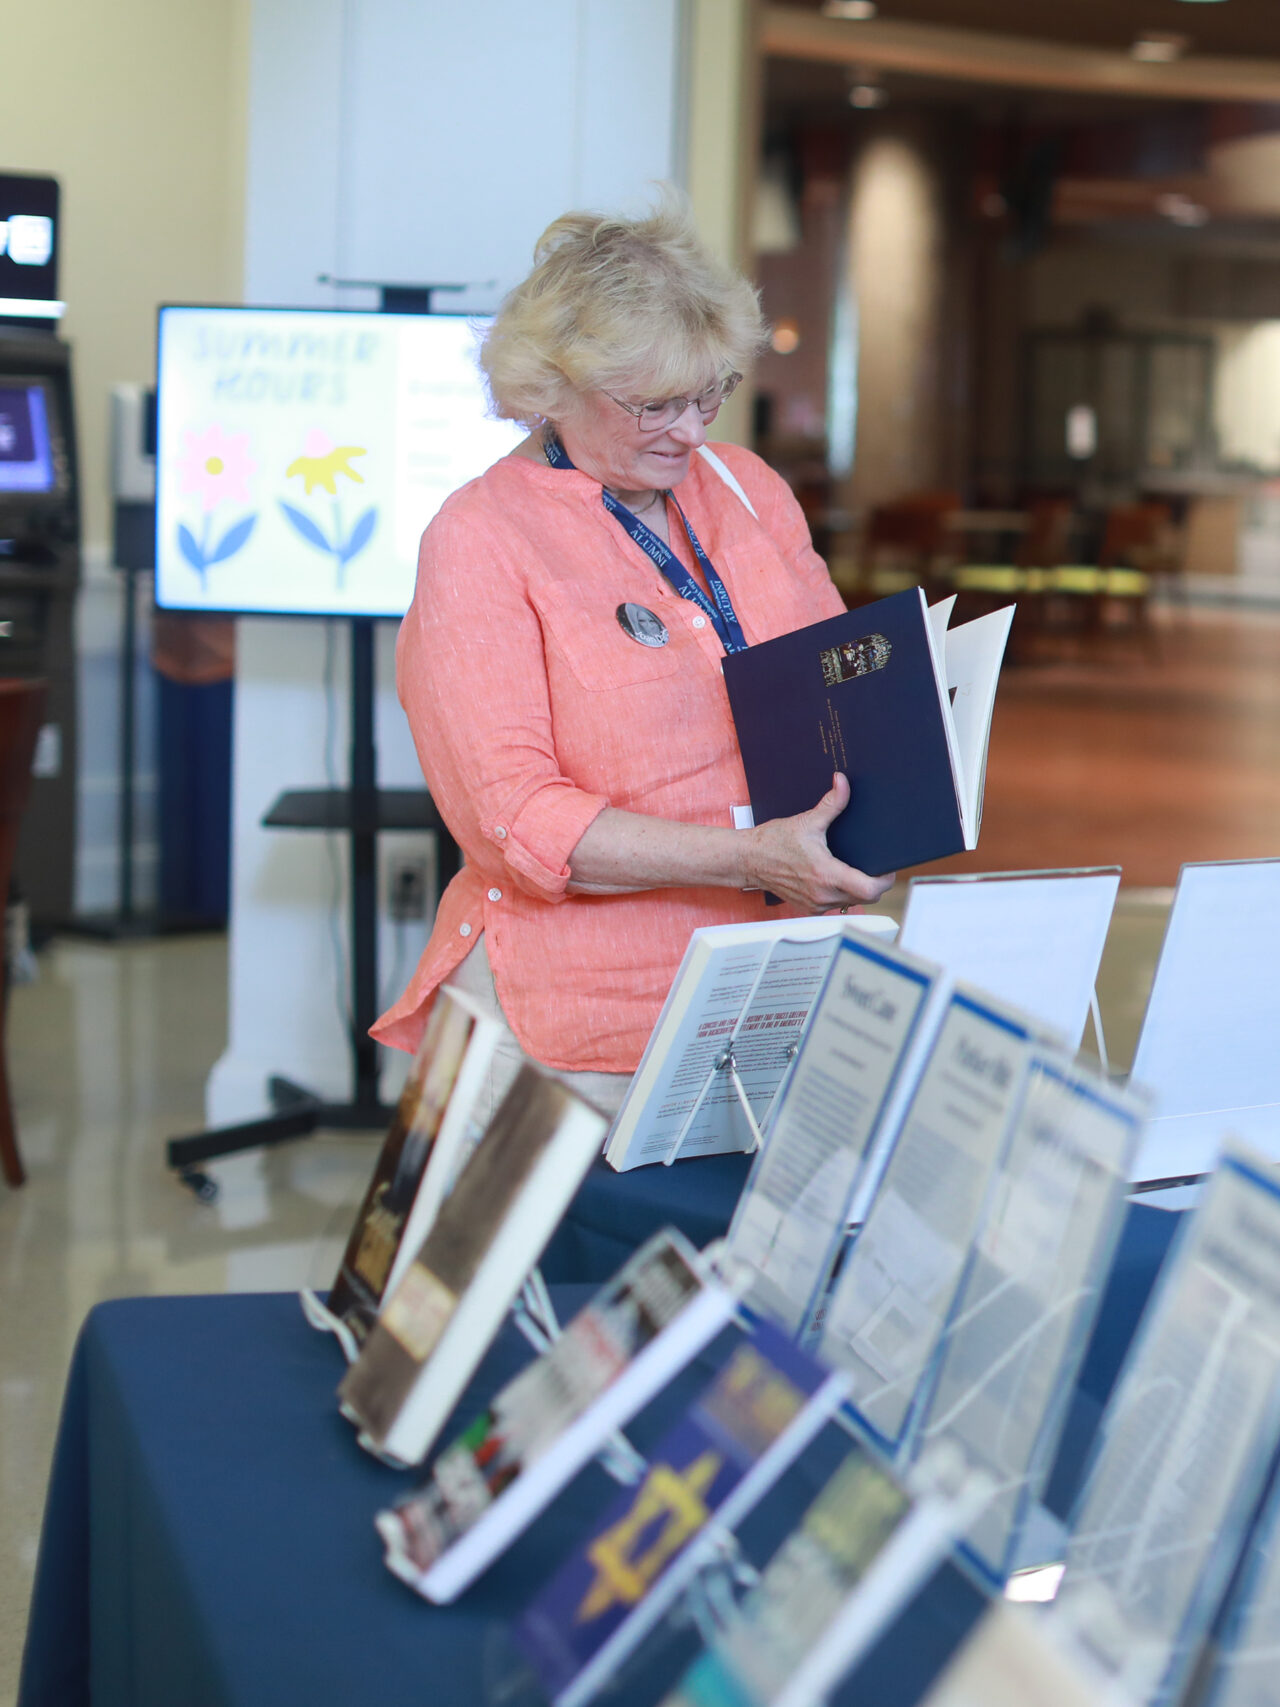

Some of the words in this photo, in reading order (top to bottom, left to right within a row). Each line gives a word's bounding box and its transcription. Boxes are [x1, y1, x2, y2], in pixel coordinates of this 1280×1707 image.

[192, 325, 379, 363] SUMMER
[212, 369, 348, 406] HOURS
[630, 529, 668, 567] ALUMNI
[636, 522, 651, 539] Mary
[649, 531, 673, 560] Washington
[685, 578, 700, 595] Mary
[697, 590, 719, 619] Washington
[714, 580, 738, 623] ALUMNI
[747, 1014, 764, 1022] HISTORY
[764, 1013, 774, 1021] THAT
[774, 1011, 789, 1020] TRACES
